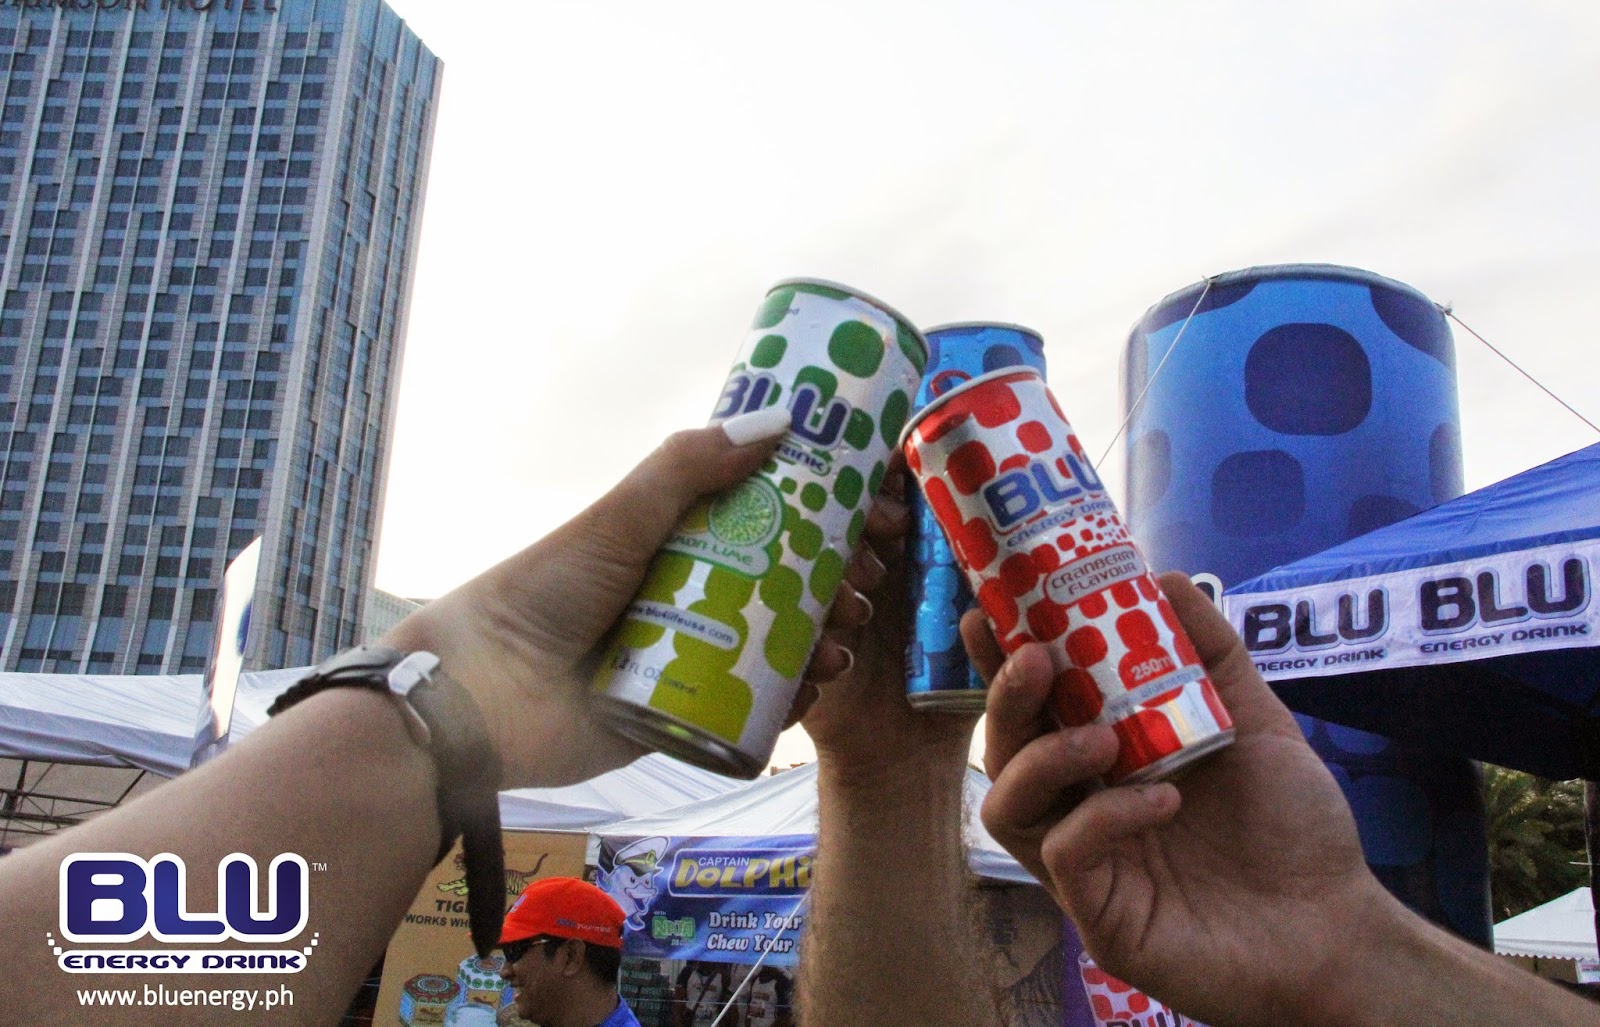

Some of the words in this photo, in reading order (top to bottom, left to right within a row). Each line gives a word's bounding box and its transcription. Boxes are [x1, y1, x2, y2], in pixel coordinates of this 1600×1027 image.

[984, 453, 1104, 528] BLU
[1418, 555, 1588, 633] BLU
[1242, 586, 1388, 654] BLU
[1419, 633, 1504, 653] ENERGY
[1511, 623, 1588, 641] DRINK
[1254, 658, 1319, 673] NERGY
[1324, 648, 1387, 666] DRINK
[699, 857, 750, 867] CAPTAIN
[405, 914, 447, 927] WORKS
[709, 911, 759, 929] Drink
[763, 913, 803, 931] Your
[707, 933, 749, 951] Chew
[754, 935, 794, 953] Your
